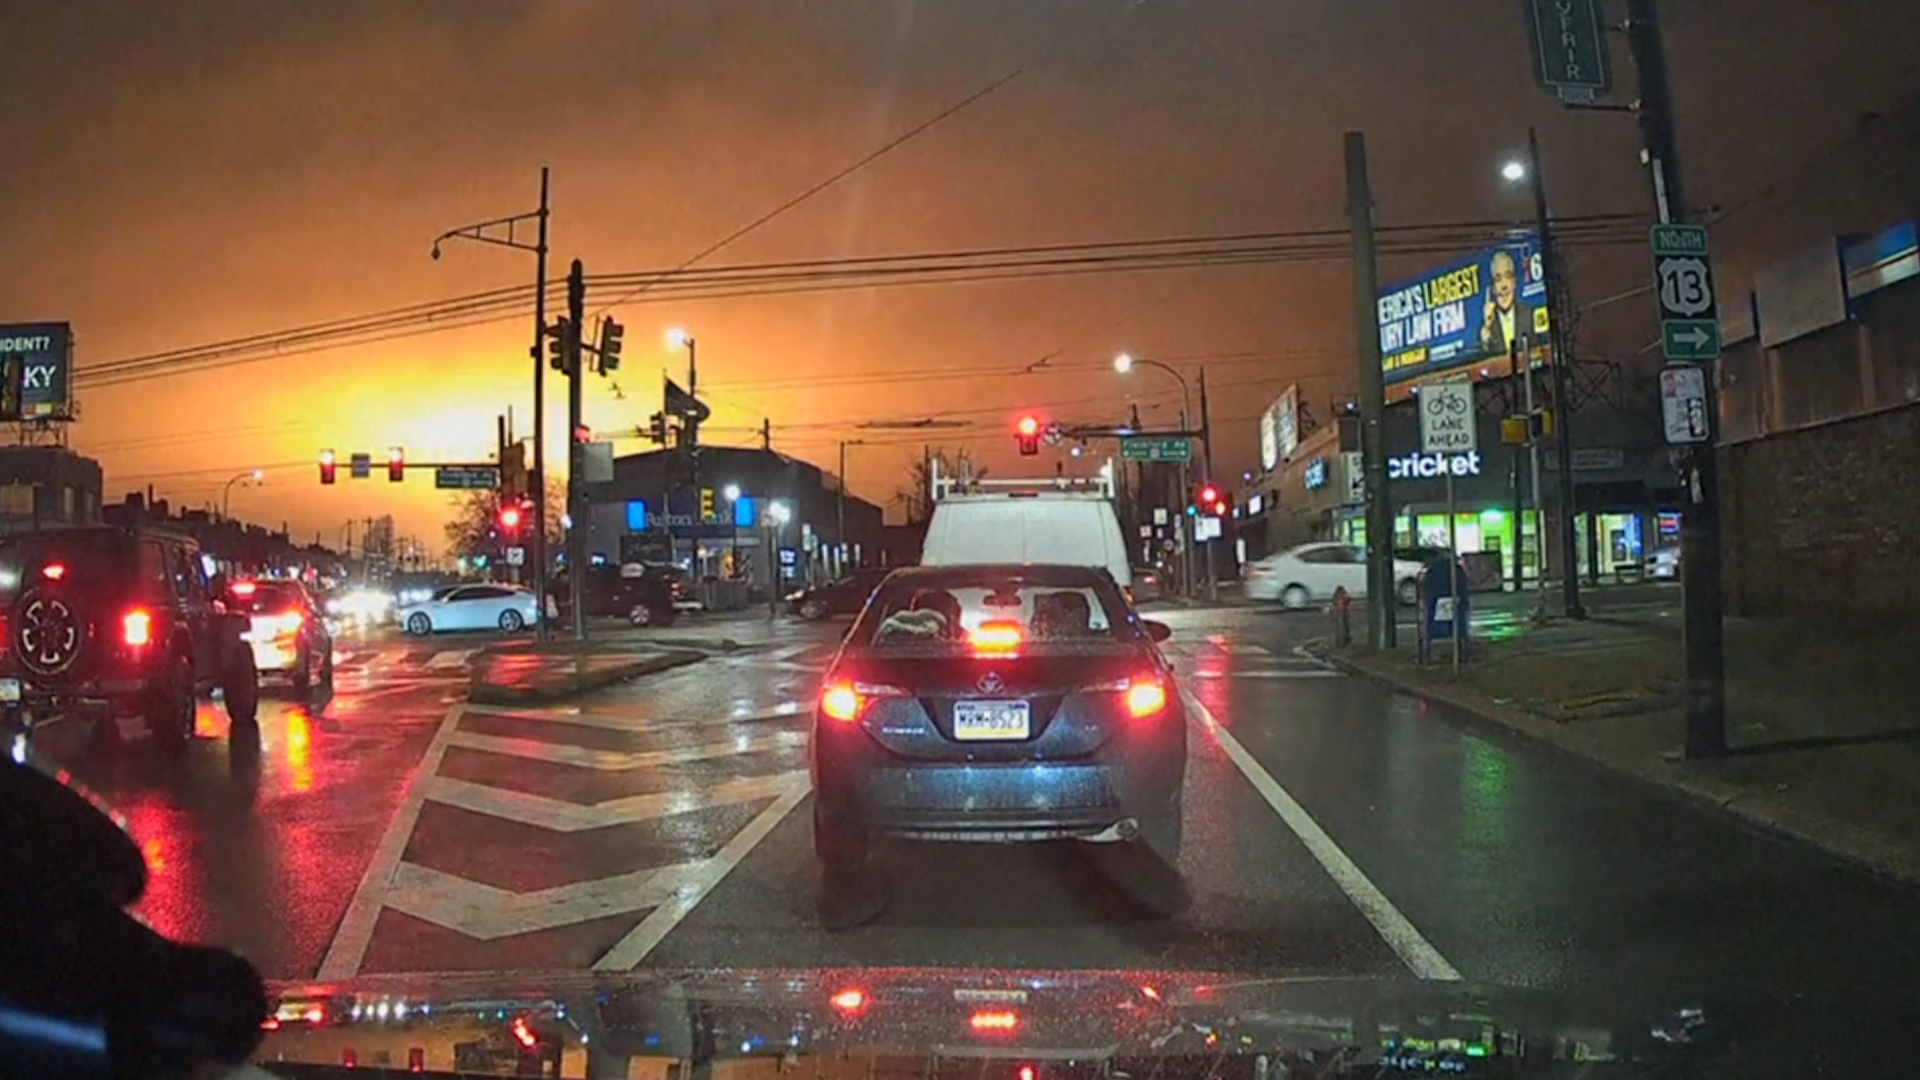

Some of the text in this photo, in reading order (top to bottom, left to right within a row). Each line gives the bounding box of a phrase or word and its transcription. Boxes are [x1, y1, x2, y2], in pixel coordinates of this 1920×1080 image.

[1423, 264, 1480, 309] LARGEST
[1667, 269, 1703, 304] 13
[1405, 310, 1432, 345] LAW
[1433, 300, 1466, 338] FIRM
[23, 365, 57, 388] KY
[1431, 418, 1465, 431] LANE
[1428, 433, 1470, 447] AHEAD
[1388, 450, 1480, 478] cricket
